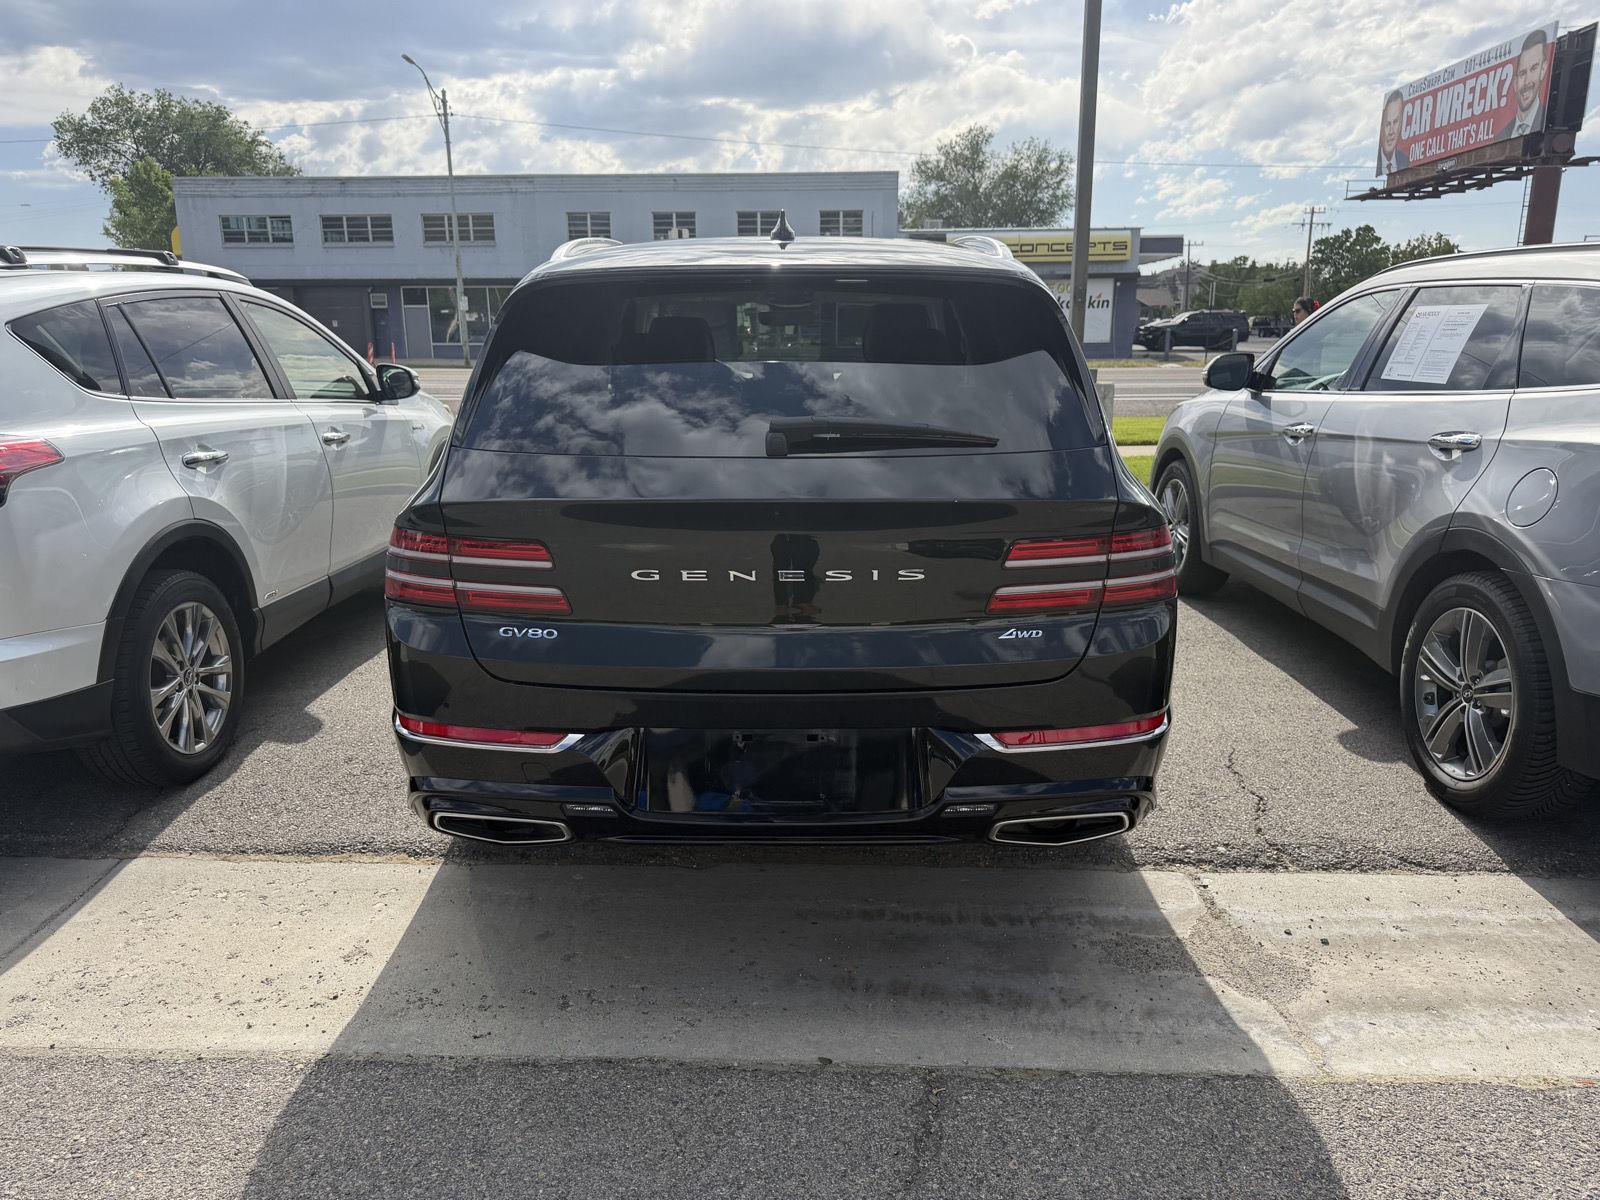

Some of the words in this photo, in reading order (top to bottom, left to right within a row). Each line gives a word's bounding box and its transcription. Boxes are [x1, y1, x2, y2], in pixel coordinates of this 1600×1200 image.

[1401, 95, 1433, 140] CAR
[1434, 63, 1513, 129] WRECK?
[1409, 140, 1426, 162] ONE
[1426, 134, 1445, 157] CALL
[1447, 122, 1477, 151] THAT'S
[1477, 118, 1494, 142] ALL
[631, 569, 925, 582] GENESIS
[499, 626, 558, 639] GV80
[997, 628, 1043, 639] 4WD
